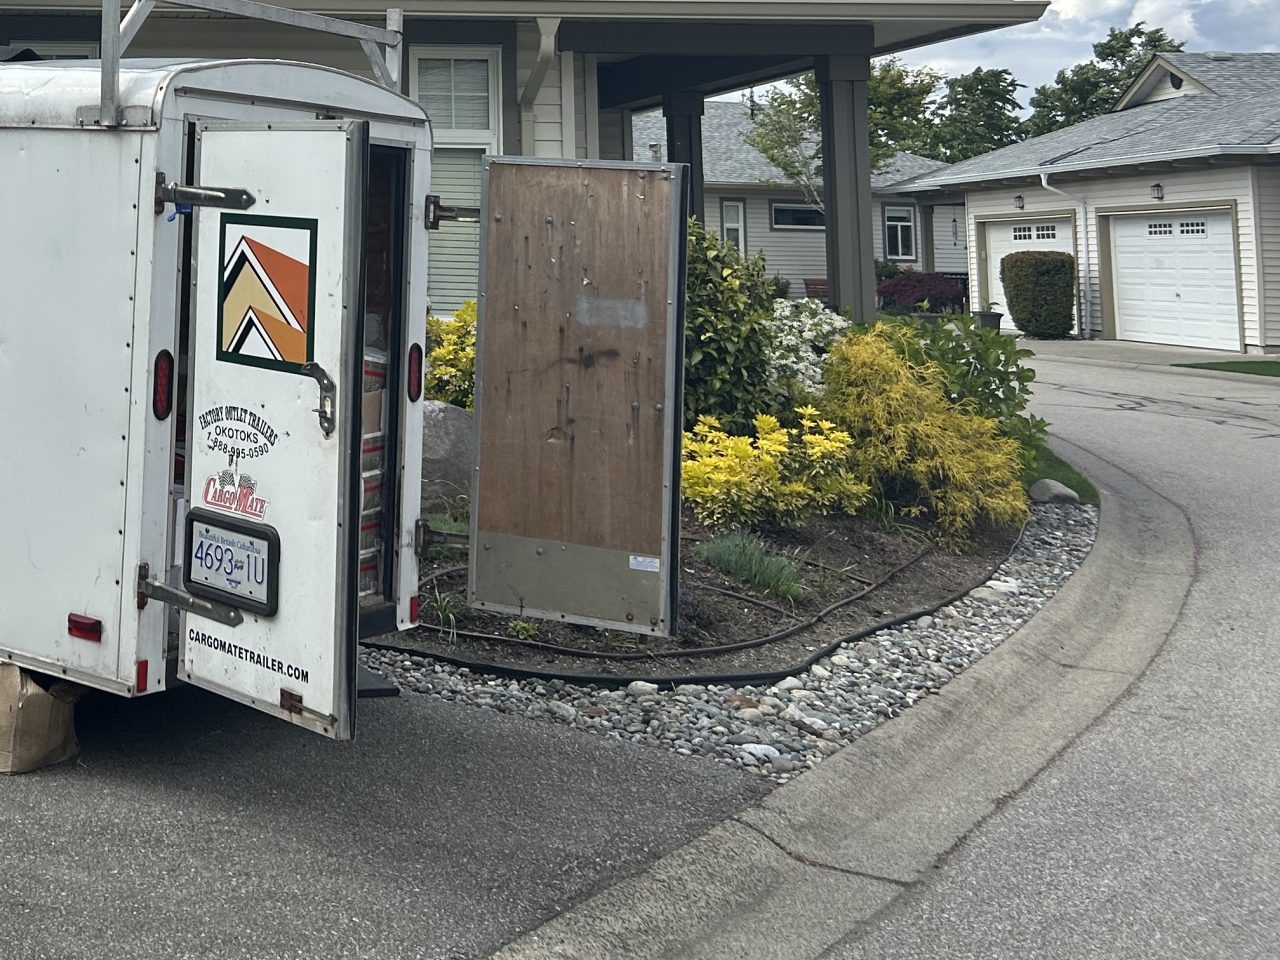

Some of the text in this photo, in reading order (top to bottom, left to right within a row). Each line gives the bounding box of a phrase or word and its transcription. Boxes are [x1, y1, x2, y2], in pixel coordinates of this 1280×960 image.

[199, 405, 279, 447] FACTORY OUTLET TRAILERS
[214, 425, 259, 444] OKOTOKS
[206, 431, 269, 460] 1-888-995-0590
[195, 539, 234, 576] 4693
[188, 628, 309, 684] CARGOMATETRAILER.COM
